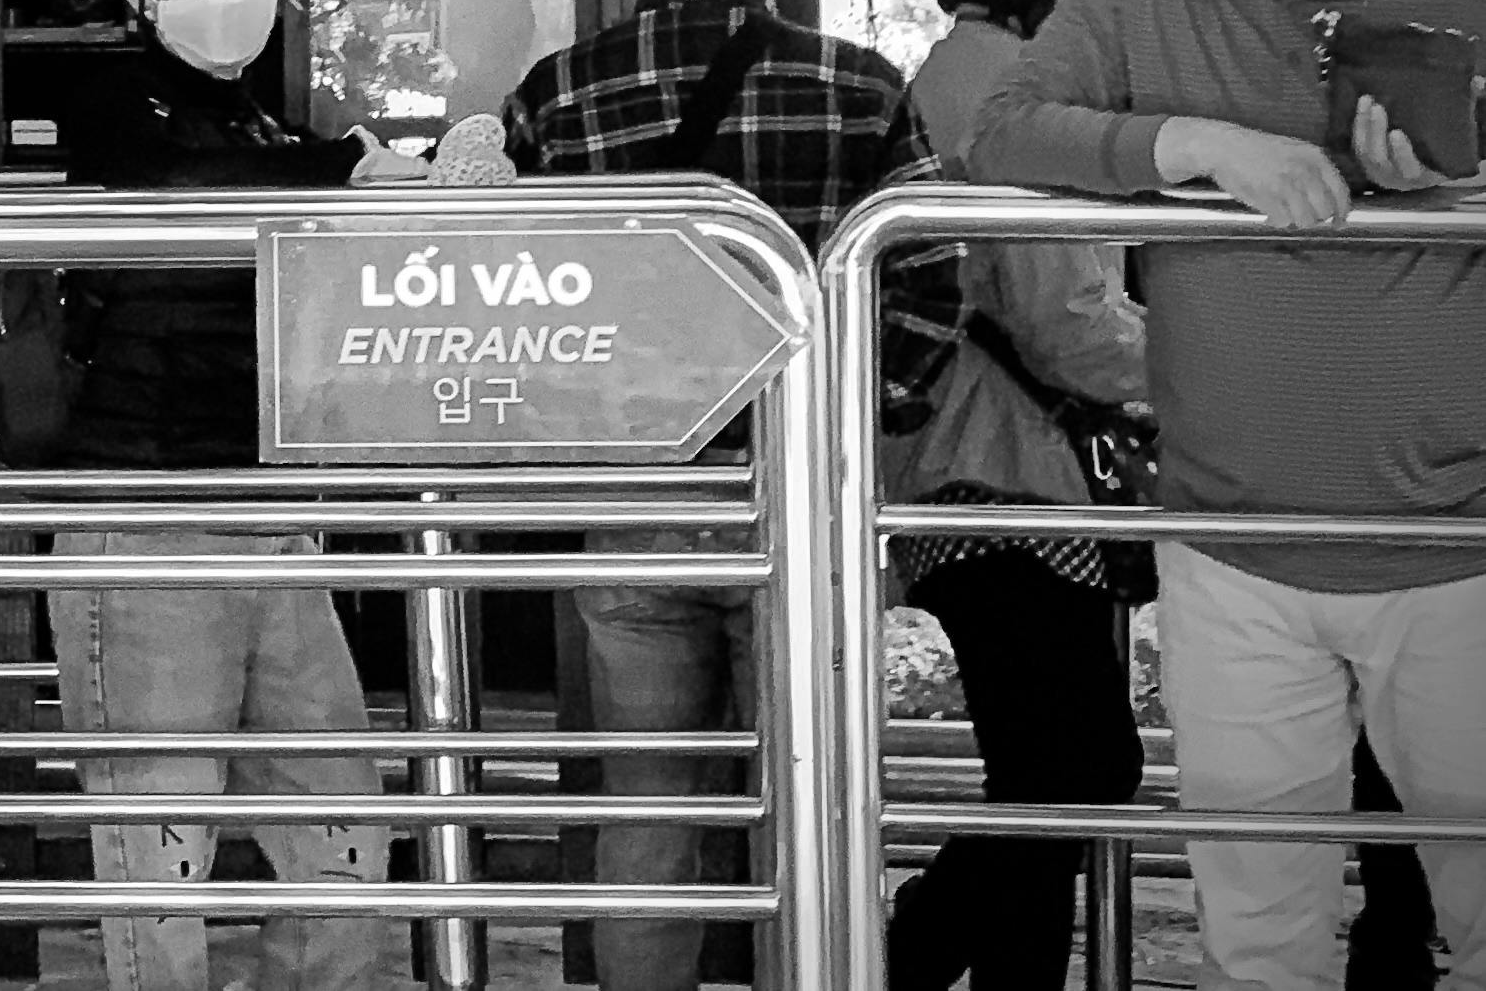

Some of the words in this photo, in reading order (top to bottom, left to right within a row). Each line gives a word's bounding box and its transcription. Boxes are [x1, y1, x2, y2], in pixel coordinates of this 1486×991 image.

[361, 245, 455, 307] LỐI
[470, 250, 593, 306] VÀO
[338, 324, 620, 364] ENTRANCE
[433, 376, 524, 425] 입구
